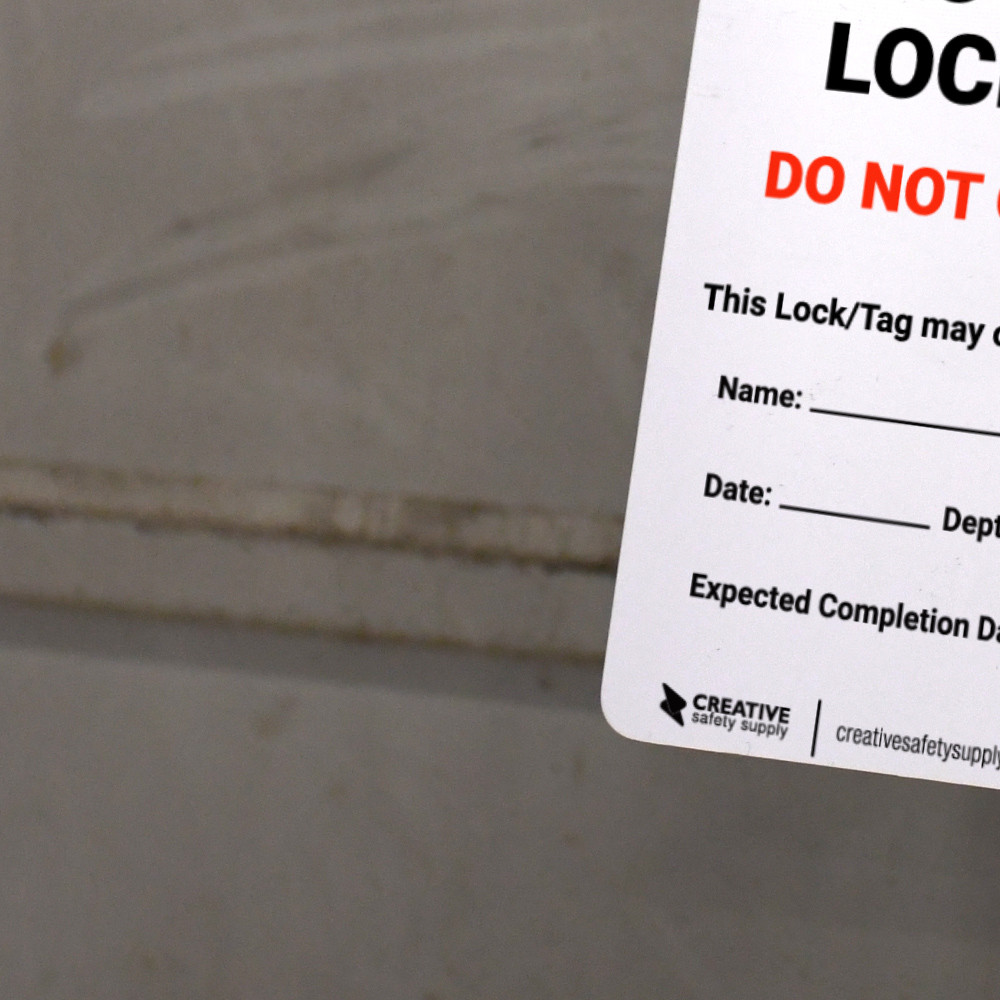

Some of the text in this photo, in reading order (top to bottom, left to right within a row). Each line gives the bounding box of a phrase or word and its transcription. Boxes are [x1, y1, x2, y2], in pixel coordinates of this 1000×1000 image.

[765, 151, 845, 204] DO
[861, 162, 984, 220] NOT
[703, 283, 766, 317] This
[775, 292, 913, 342] Lock/Tag
[921, 317, 985, 350] may
[718, 375, 802, 410] Name:
[704, 473, 772, 507] Date:
[689, 572, 812, 615] Expected
[819, 593, 969, 639] Completion
[691, 711, 789, 740] safety supply
[692, 693, 791, 724] CREATIVE
